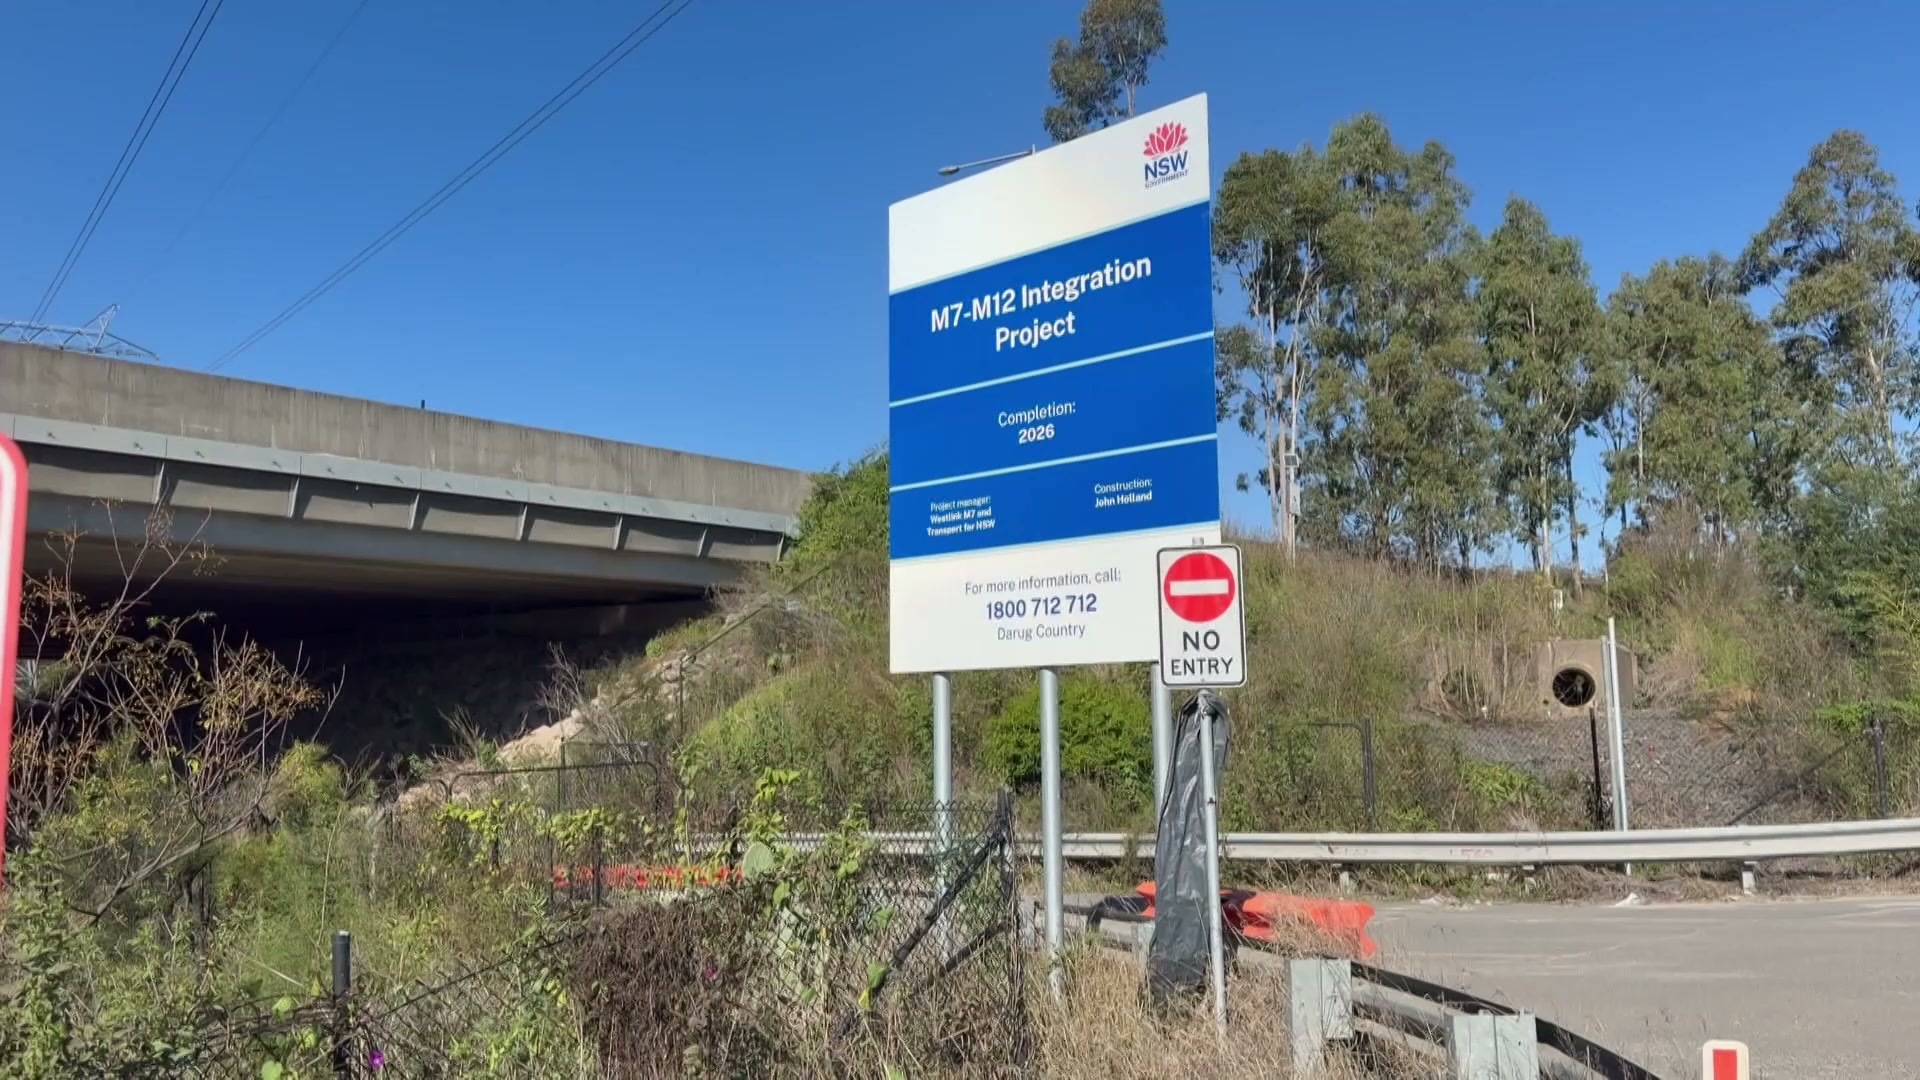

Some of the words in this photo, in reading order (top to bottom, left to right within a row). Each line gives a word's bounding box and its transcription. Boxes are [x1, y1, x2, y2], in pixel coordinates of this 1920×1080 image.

[1145, 150, 1188, 180] NSW
[931, 289, 1016, 332] M7-M12
[1021, 256, 1152, 306] Integration
[995, 311, 1076, 352] Project
[998, 401, 1076, 427] Completion:
[1018, 424, 1055, 444] 2026
[1095, 478, 1152, 494] Construction:
[930, 501, 955, 512] Project
[1095, 496, 1115, 508] John
[1117, 489, 1152, 504] Holland
[930, 511, 962, 524] Westlink
[964, 509, 975, 519] M7
[977, 506, 992, 518] and
[927, 524, 962, 536] Transport
[964, 522, 975, 532] for
[976, 519, 996, 530] NSW
[965, 581, 983, 596] For
[986, 580, 1015, 593] more
[1095, 568, 1121, 583] call:
[986, 599, 1027, 620] 1800
[1031, 596, 1061, 617] 712
[1065, 593, 1098, 614] 712
[997, 627, 1032, 642] Darug
[1036, 623, 1086, 638] Country
[1183, 630, 1220, 651] NO
[1171, 657, 1233, 676] ENTRY
